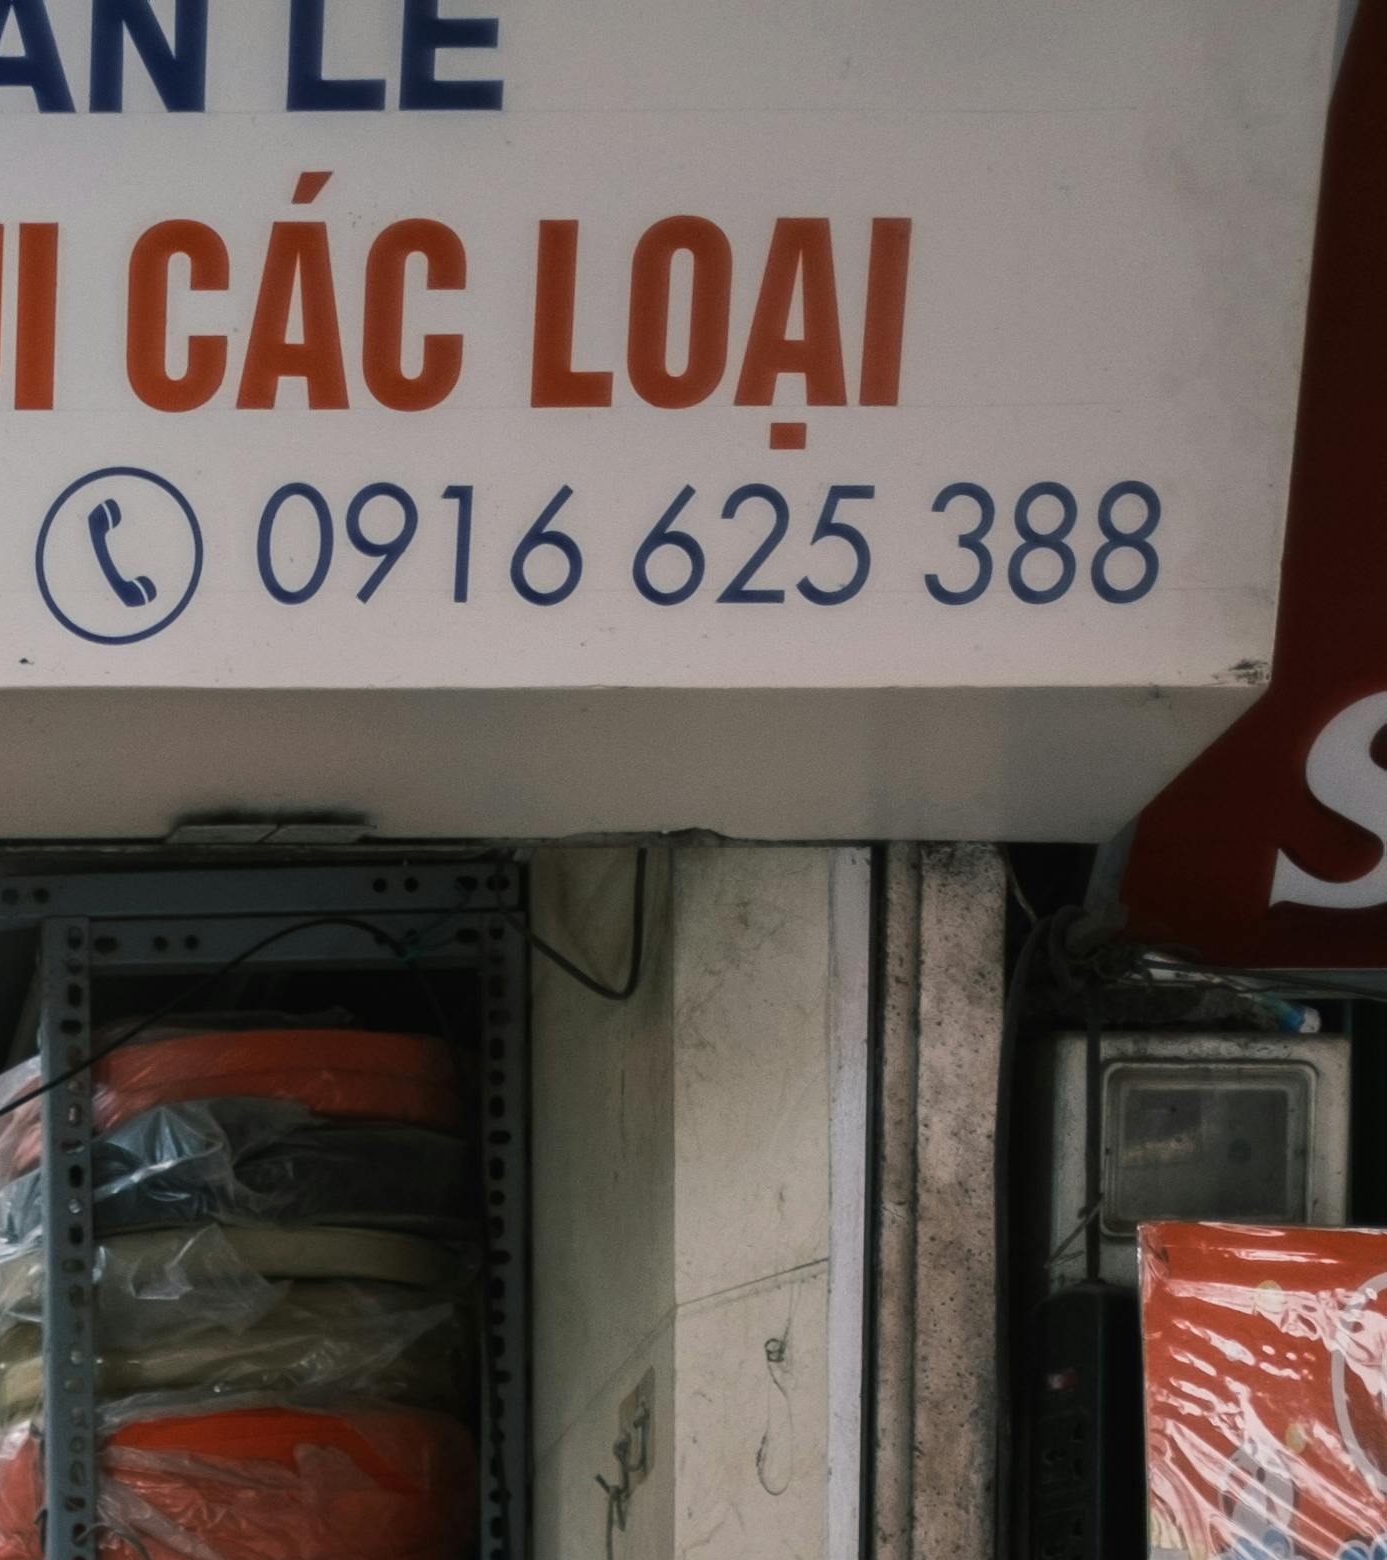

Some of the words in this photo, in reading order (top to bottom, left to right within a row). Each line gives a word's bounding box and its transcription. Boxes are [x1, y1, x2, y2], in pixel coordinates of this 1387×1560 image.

[126, 171, 467, 412] CÁC
[530, 214, 913, 451] LOẠI
[257, 482, 583, 605] 0916
[631, 483, 876, 605] 625
[924, 480, 1164, 605] 388
